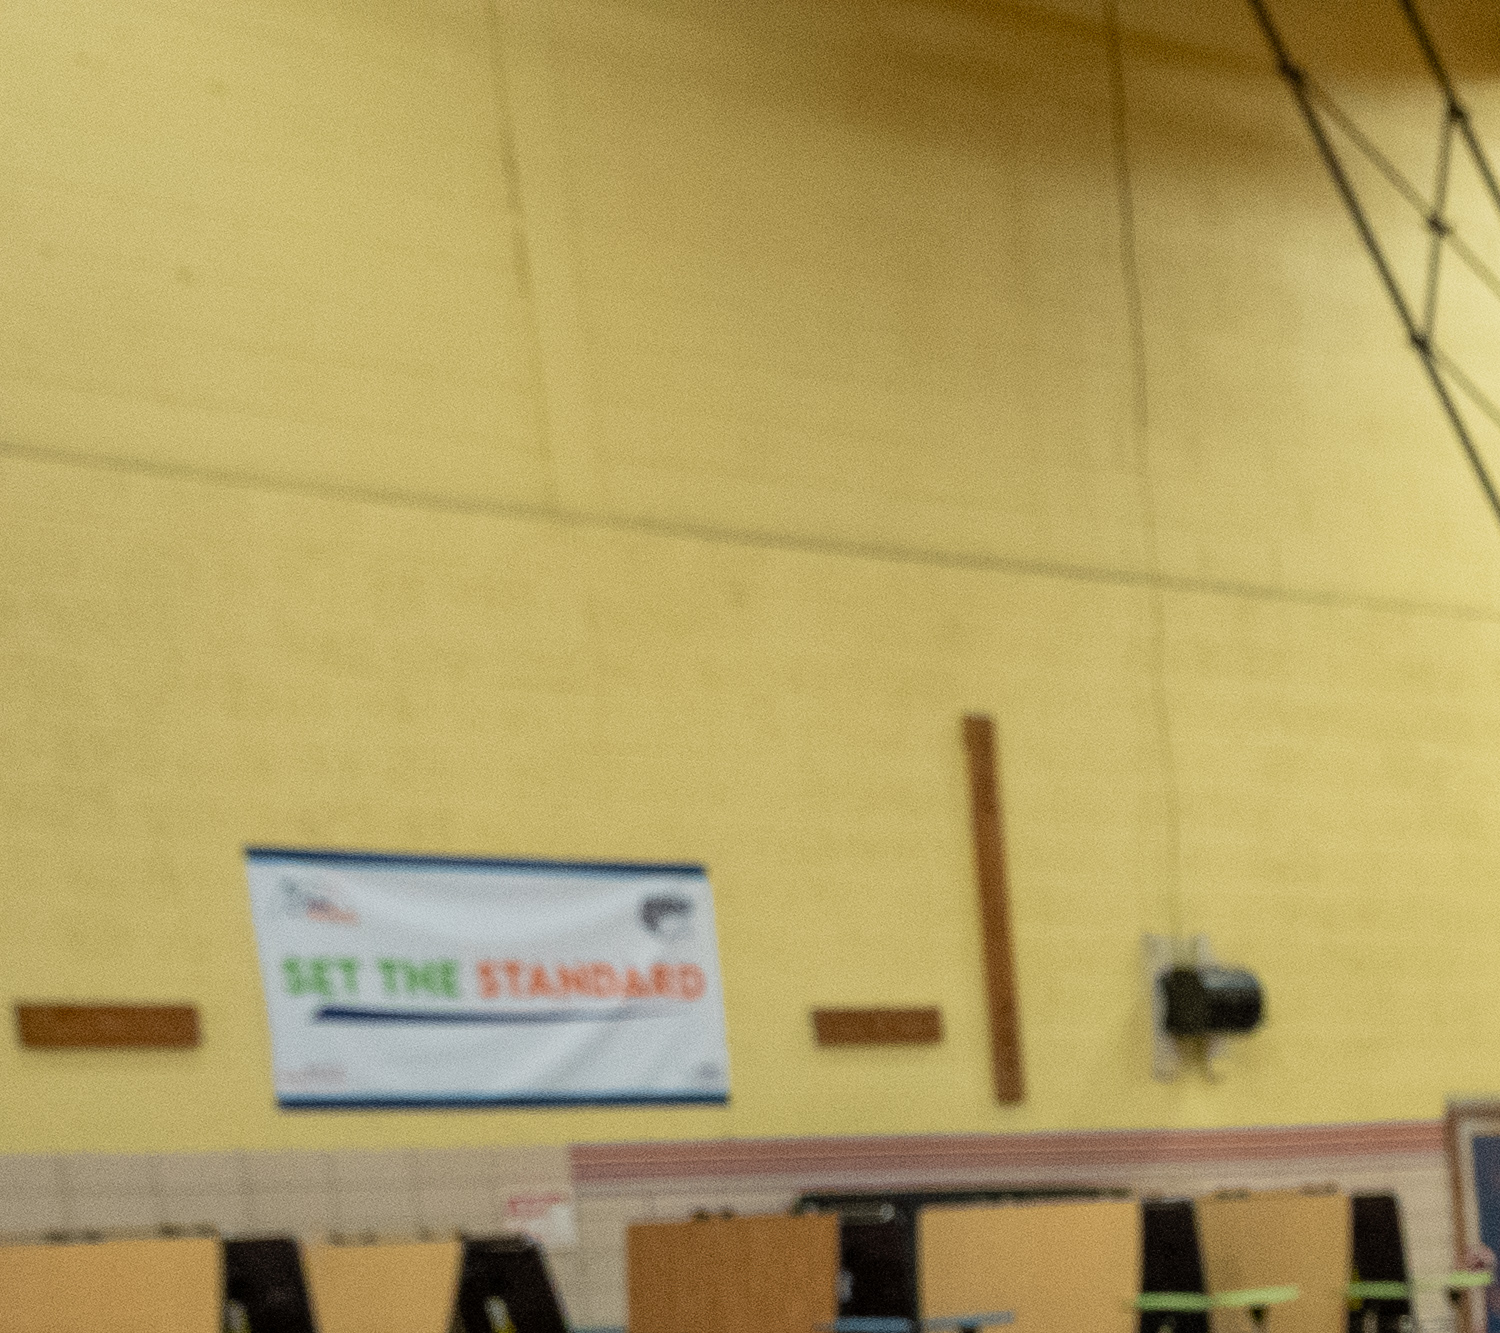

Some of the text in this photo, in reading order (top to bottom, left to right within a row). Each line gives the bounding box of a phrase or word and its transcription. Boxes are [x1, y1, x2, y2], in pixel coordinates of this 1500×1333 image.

[281, 956, 707, 1003] SET THE STANDARD
